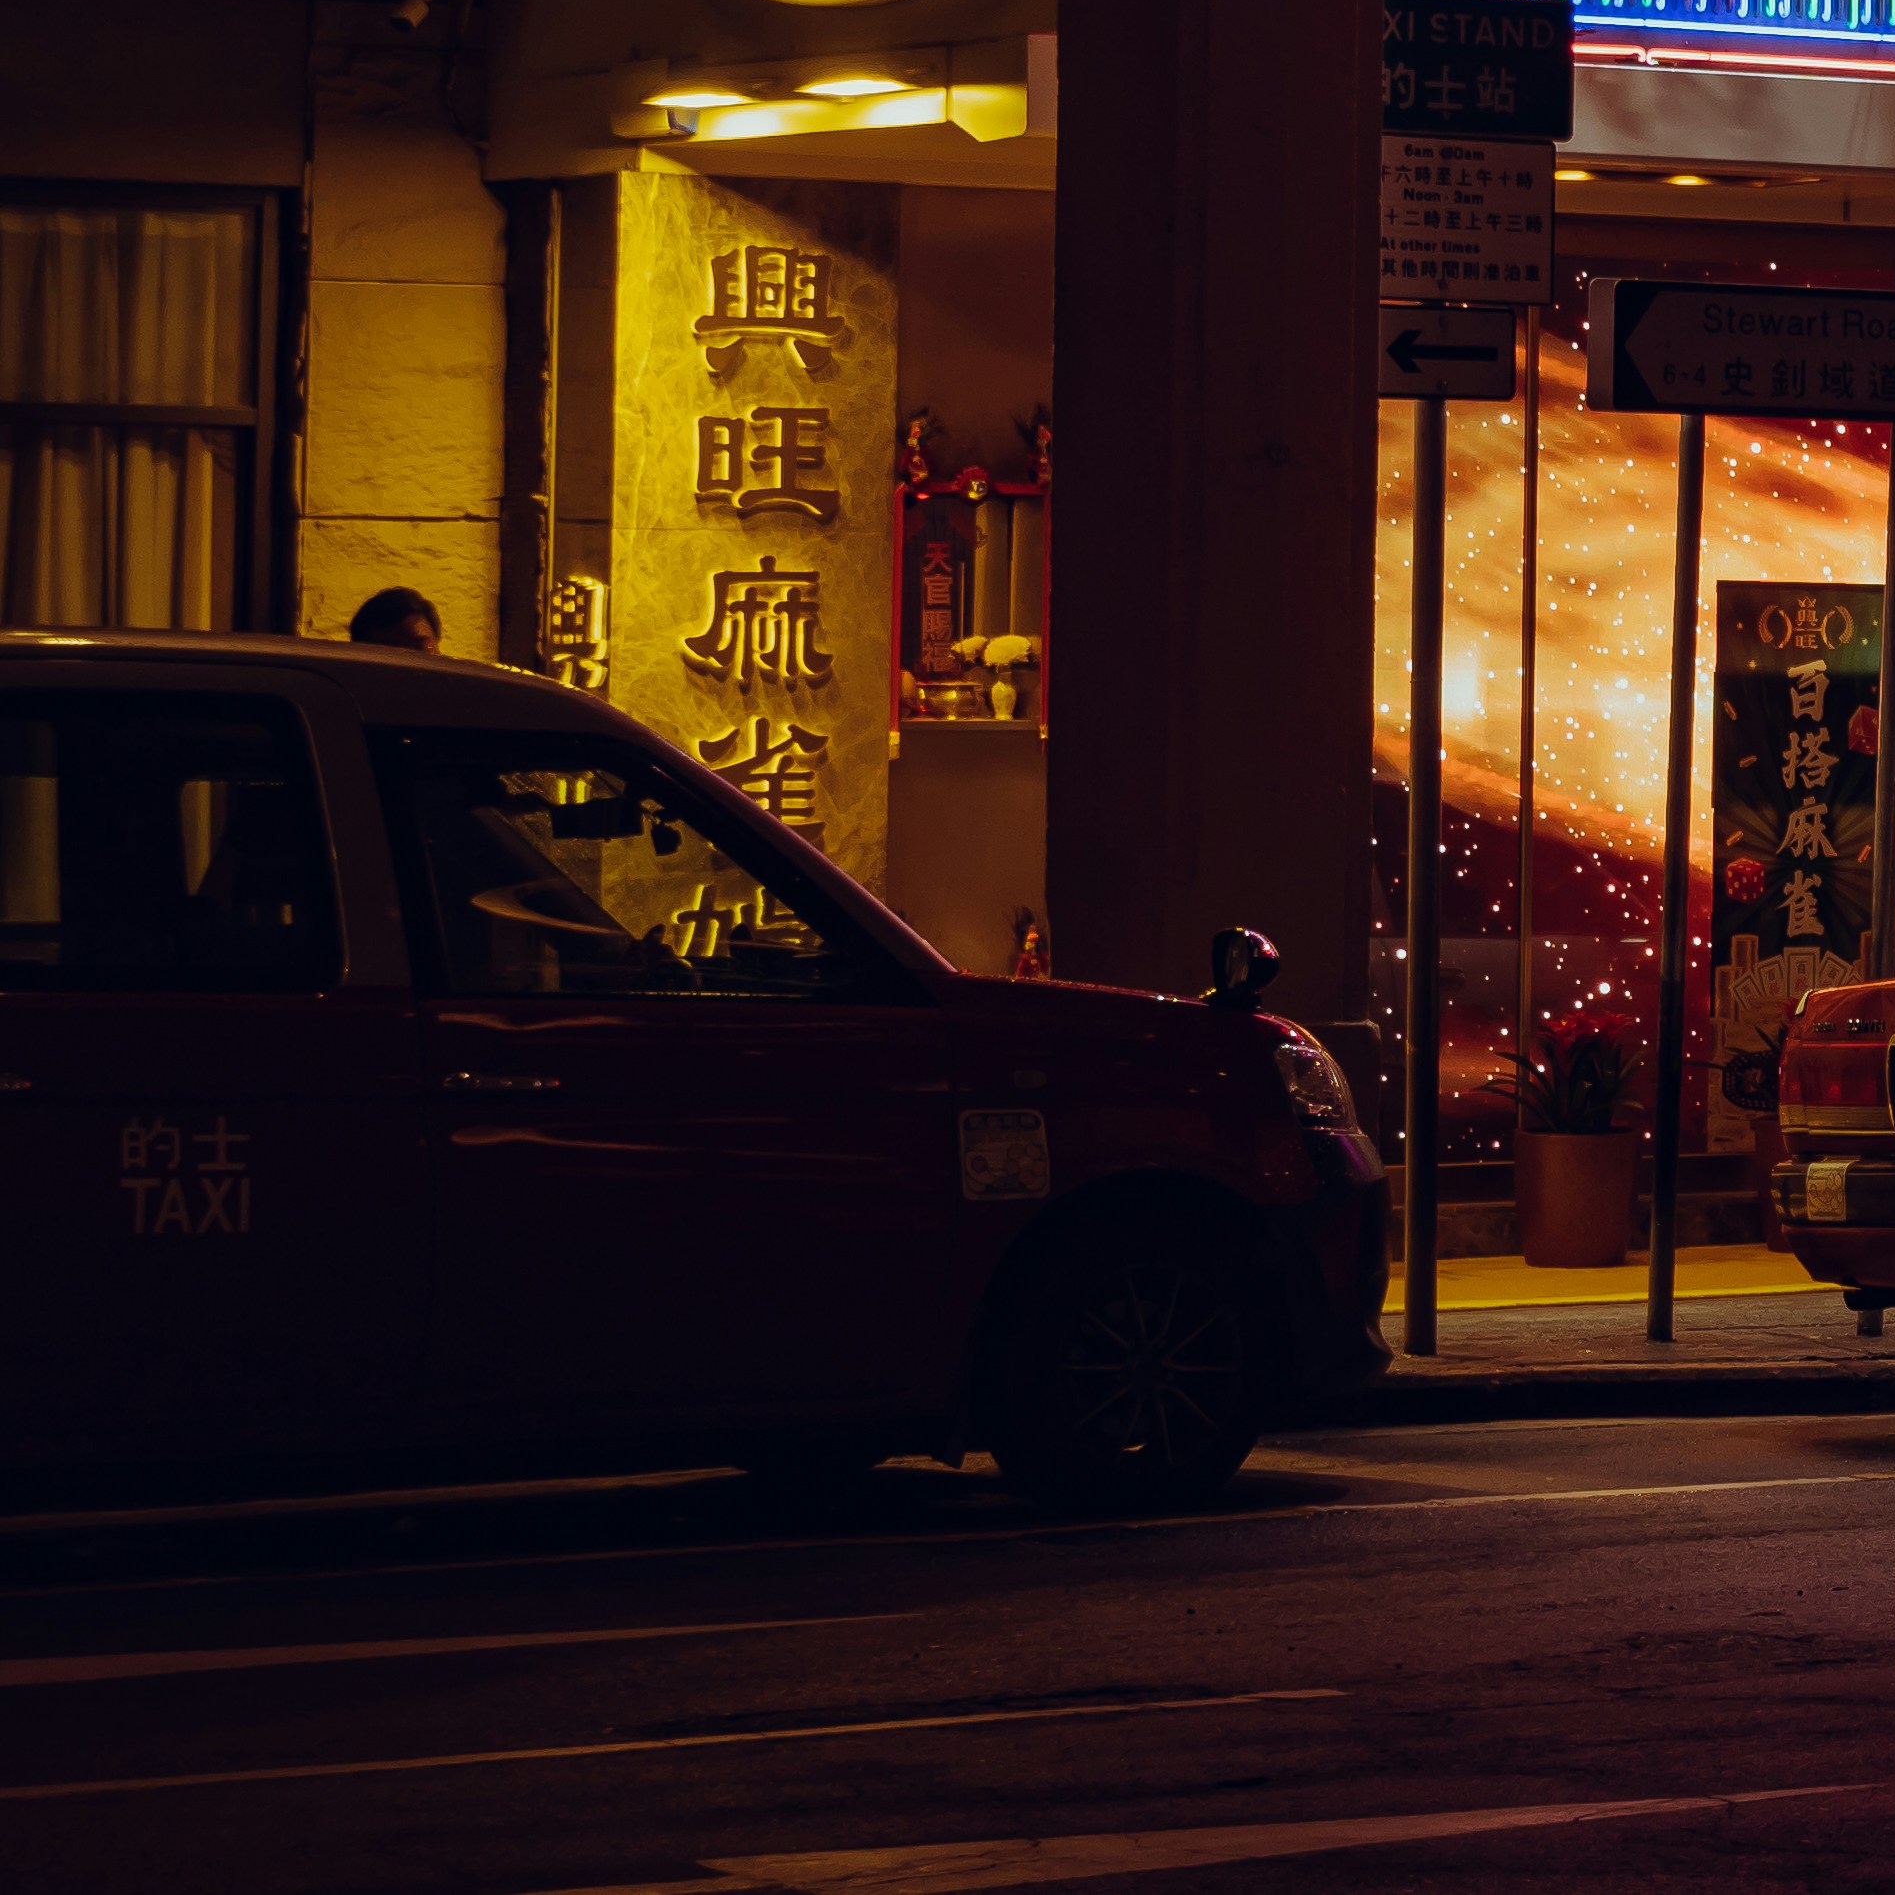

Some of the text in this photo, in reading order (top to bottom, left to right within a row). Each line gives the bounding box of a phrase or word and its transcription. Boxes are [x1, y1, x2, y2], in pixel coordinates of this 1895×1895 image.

[1430, 14, 1555, 49] STAND
[1383, 61, 1516, 116] 的士站
[1405, 144, 1434, 159] 6am
[1403, 188, 1484, 205] Noon 3am
[1401, 239, 1436, 253] other
[1442, 240, 1480, 254] times
[1703, 304, 1829, 339] Stewart
[1776, 658, 1839, 938] 百搭麻雀
[120, 1114, 252, 1171] 的士
[120, 1176, 252, 1235] TAXI
